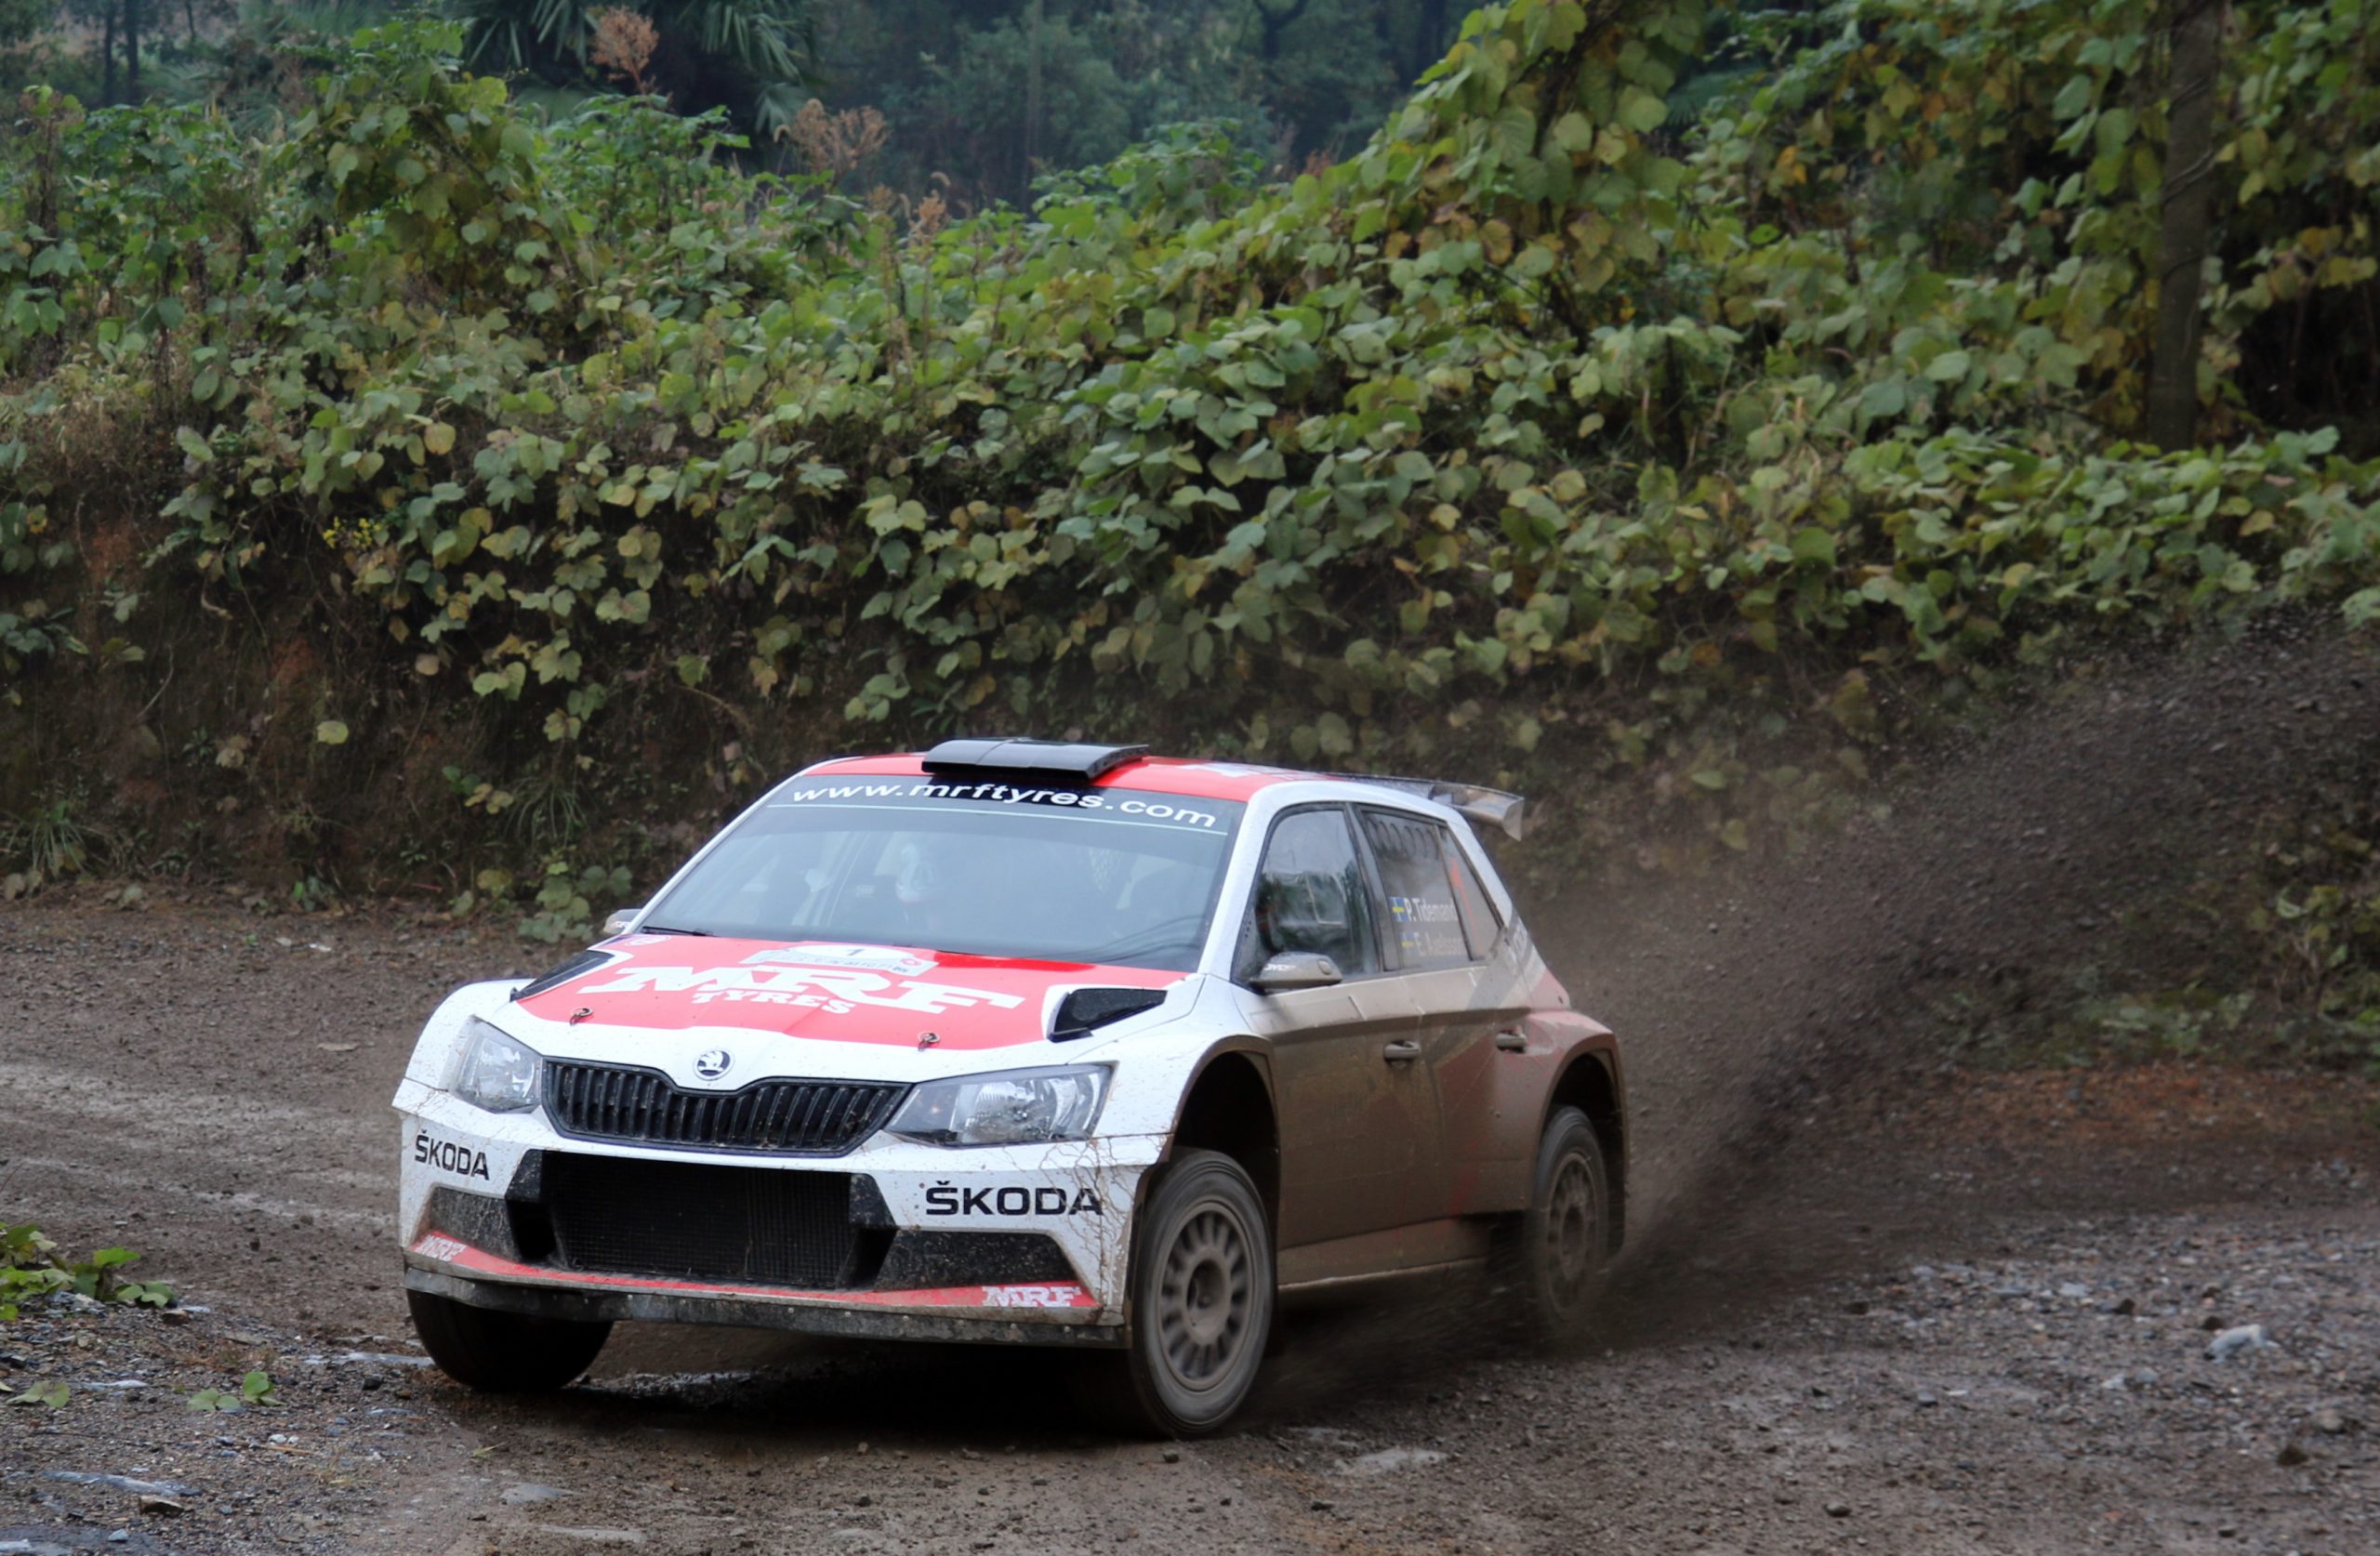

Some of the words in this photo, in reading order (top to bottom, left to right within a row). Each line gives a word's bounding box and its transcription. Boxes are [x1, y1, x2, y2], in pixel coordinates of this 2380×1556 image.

[794, 784, 1217, 827] www.mrftyres.com
[576, 967, 1025, 1014] MRF
[692, 989, 858, 1014] TYRES
[414, 1128, 490, 1181] ŠKODA
[924, 1180, 1104, 1216] ŠKODA
[415, 1233, 468, 1262] MRF
[981, 1285, 1082, 1309] MRF
